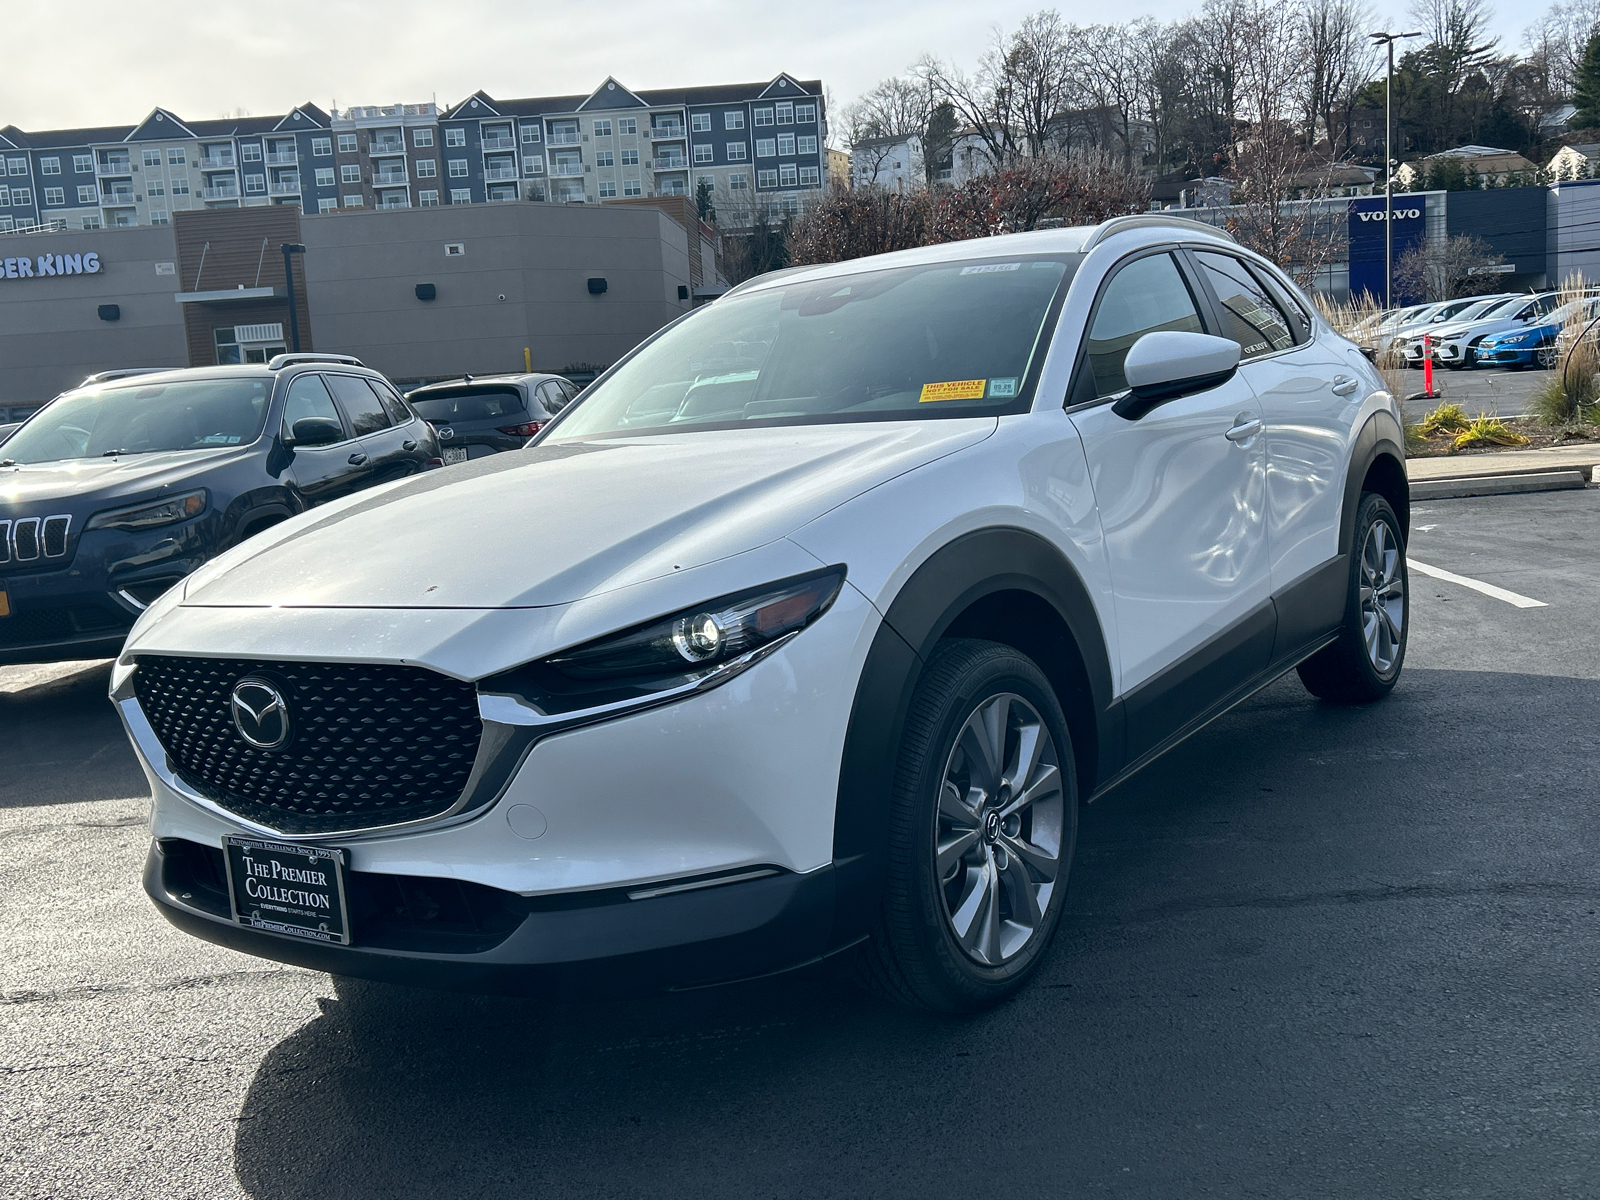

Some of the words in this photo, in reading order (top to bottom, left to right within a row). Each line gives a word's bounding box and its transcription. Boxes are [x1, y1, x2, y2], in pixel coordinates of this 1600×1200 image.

[37, 252, 100, 277] KING
[315, 849, 331, 858] 1995
[260, 903, 288, 913] EVERYTHING
[288, 907, 304, 916] STARTS
